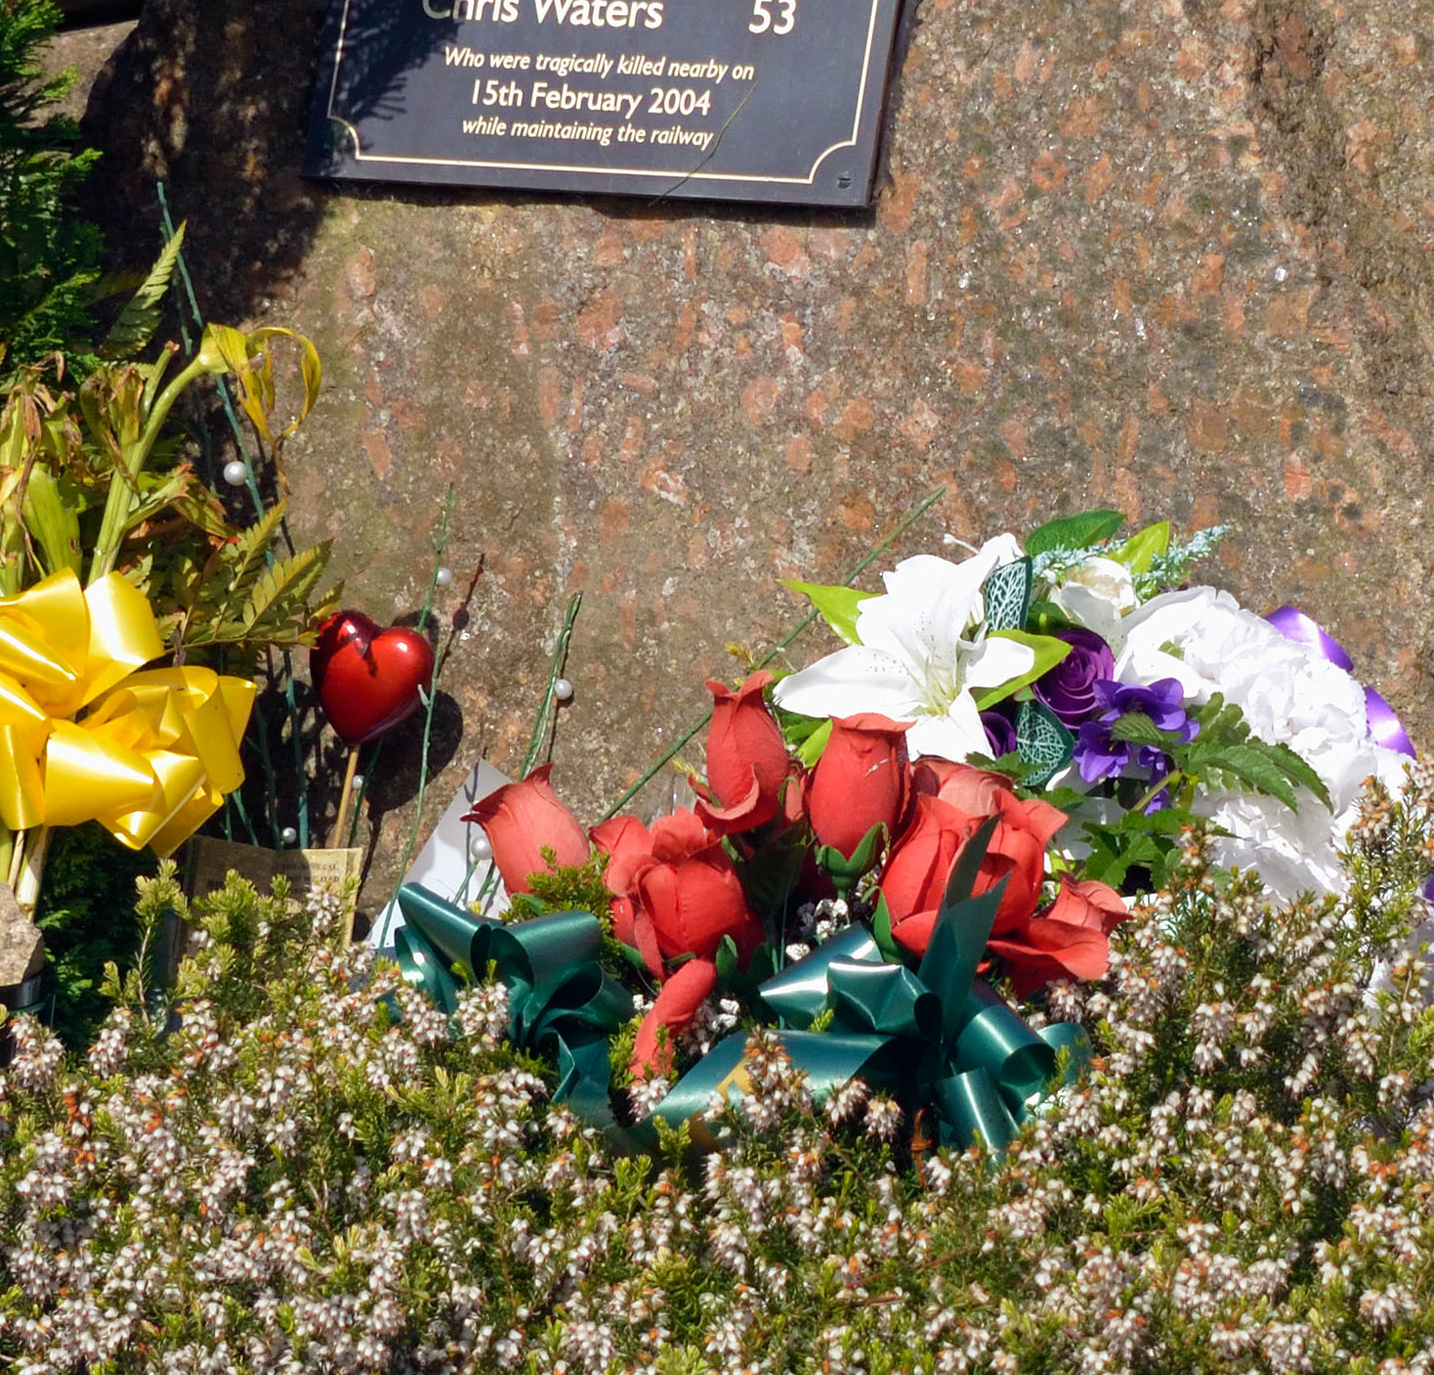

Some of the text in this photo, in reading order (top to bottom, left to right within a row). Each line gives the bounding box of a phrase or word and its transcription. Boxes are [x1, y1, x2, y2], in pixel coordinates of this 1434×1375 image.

[445, 45, 755, 85] Who were tragically killed nearby on
[471, 78, 711, 120] 15th February 2004
[462, 115, 715, 152] while maintaining the railway
